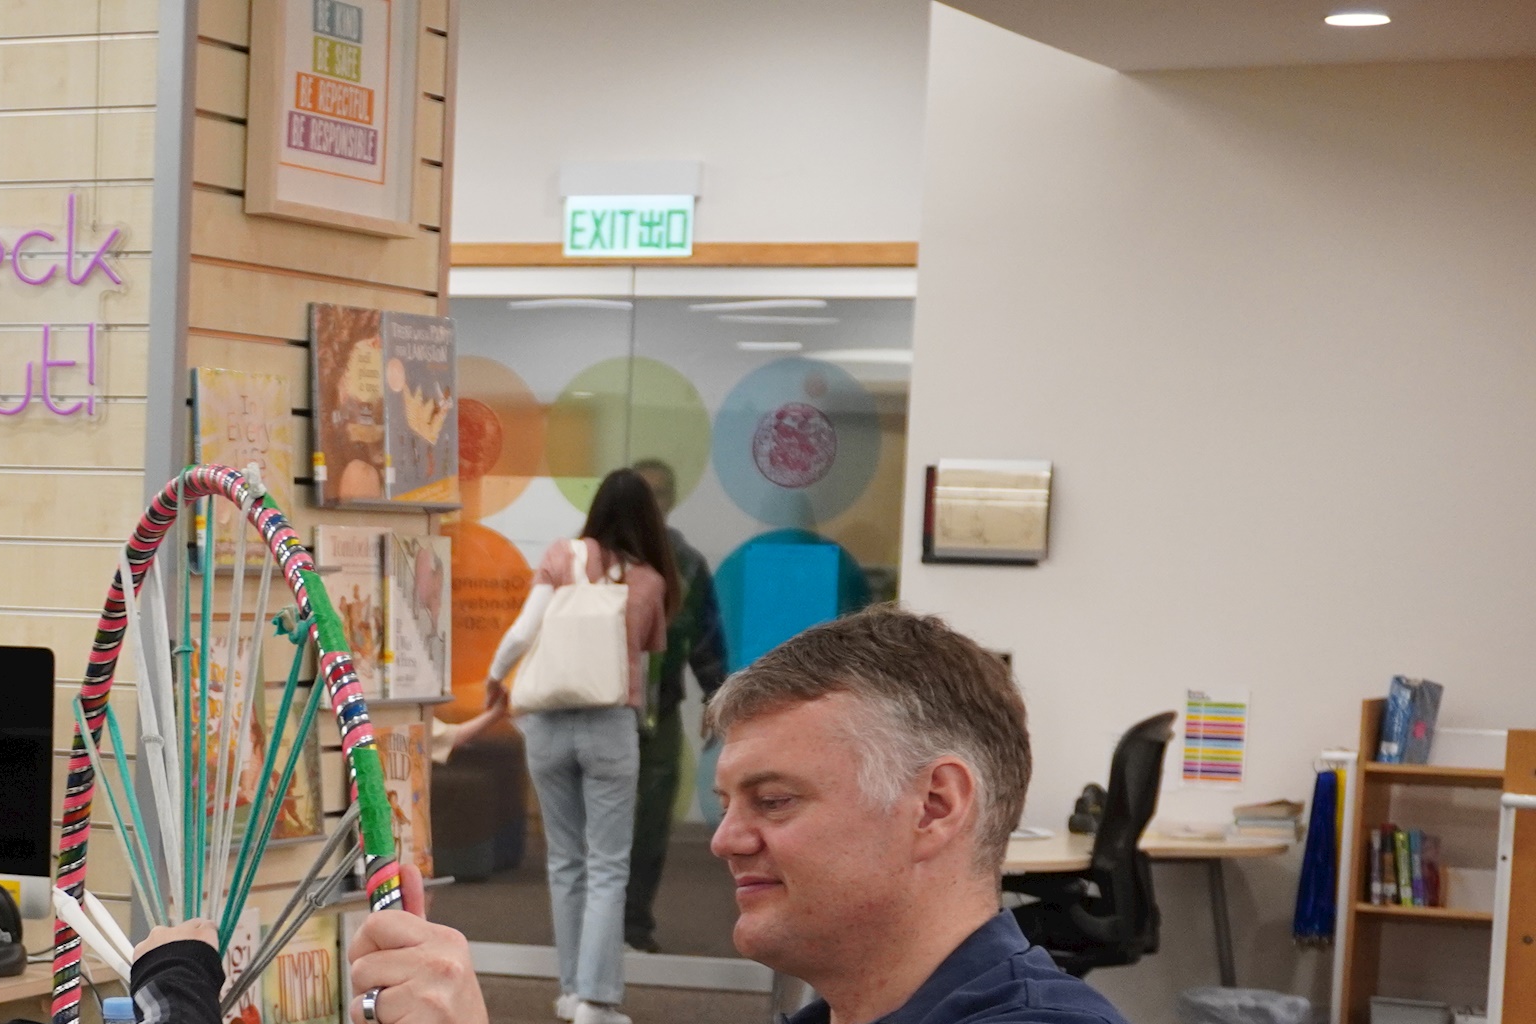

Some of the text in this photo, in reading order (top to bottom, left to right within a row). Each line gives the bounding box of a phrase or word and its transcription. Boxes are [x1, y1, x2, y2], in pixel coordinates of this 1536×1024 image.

[316, 39, 359, 79] BE SAFE
[299, 74, 314, 108] BE
[291, 113, 376, 161] BE RESPONSIBLE
[570, 210, 635, 249] EXIT
[638, 209, 688, 249] 出口
